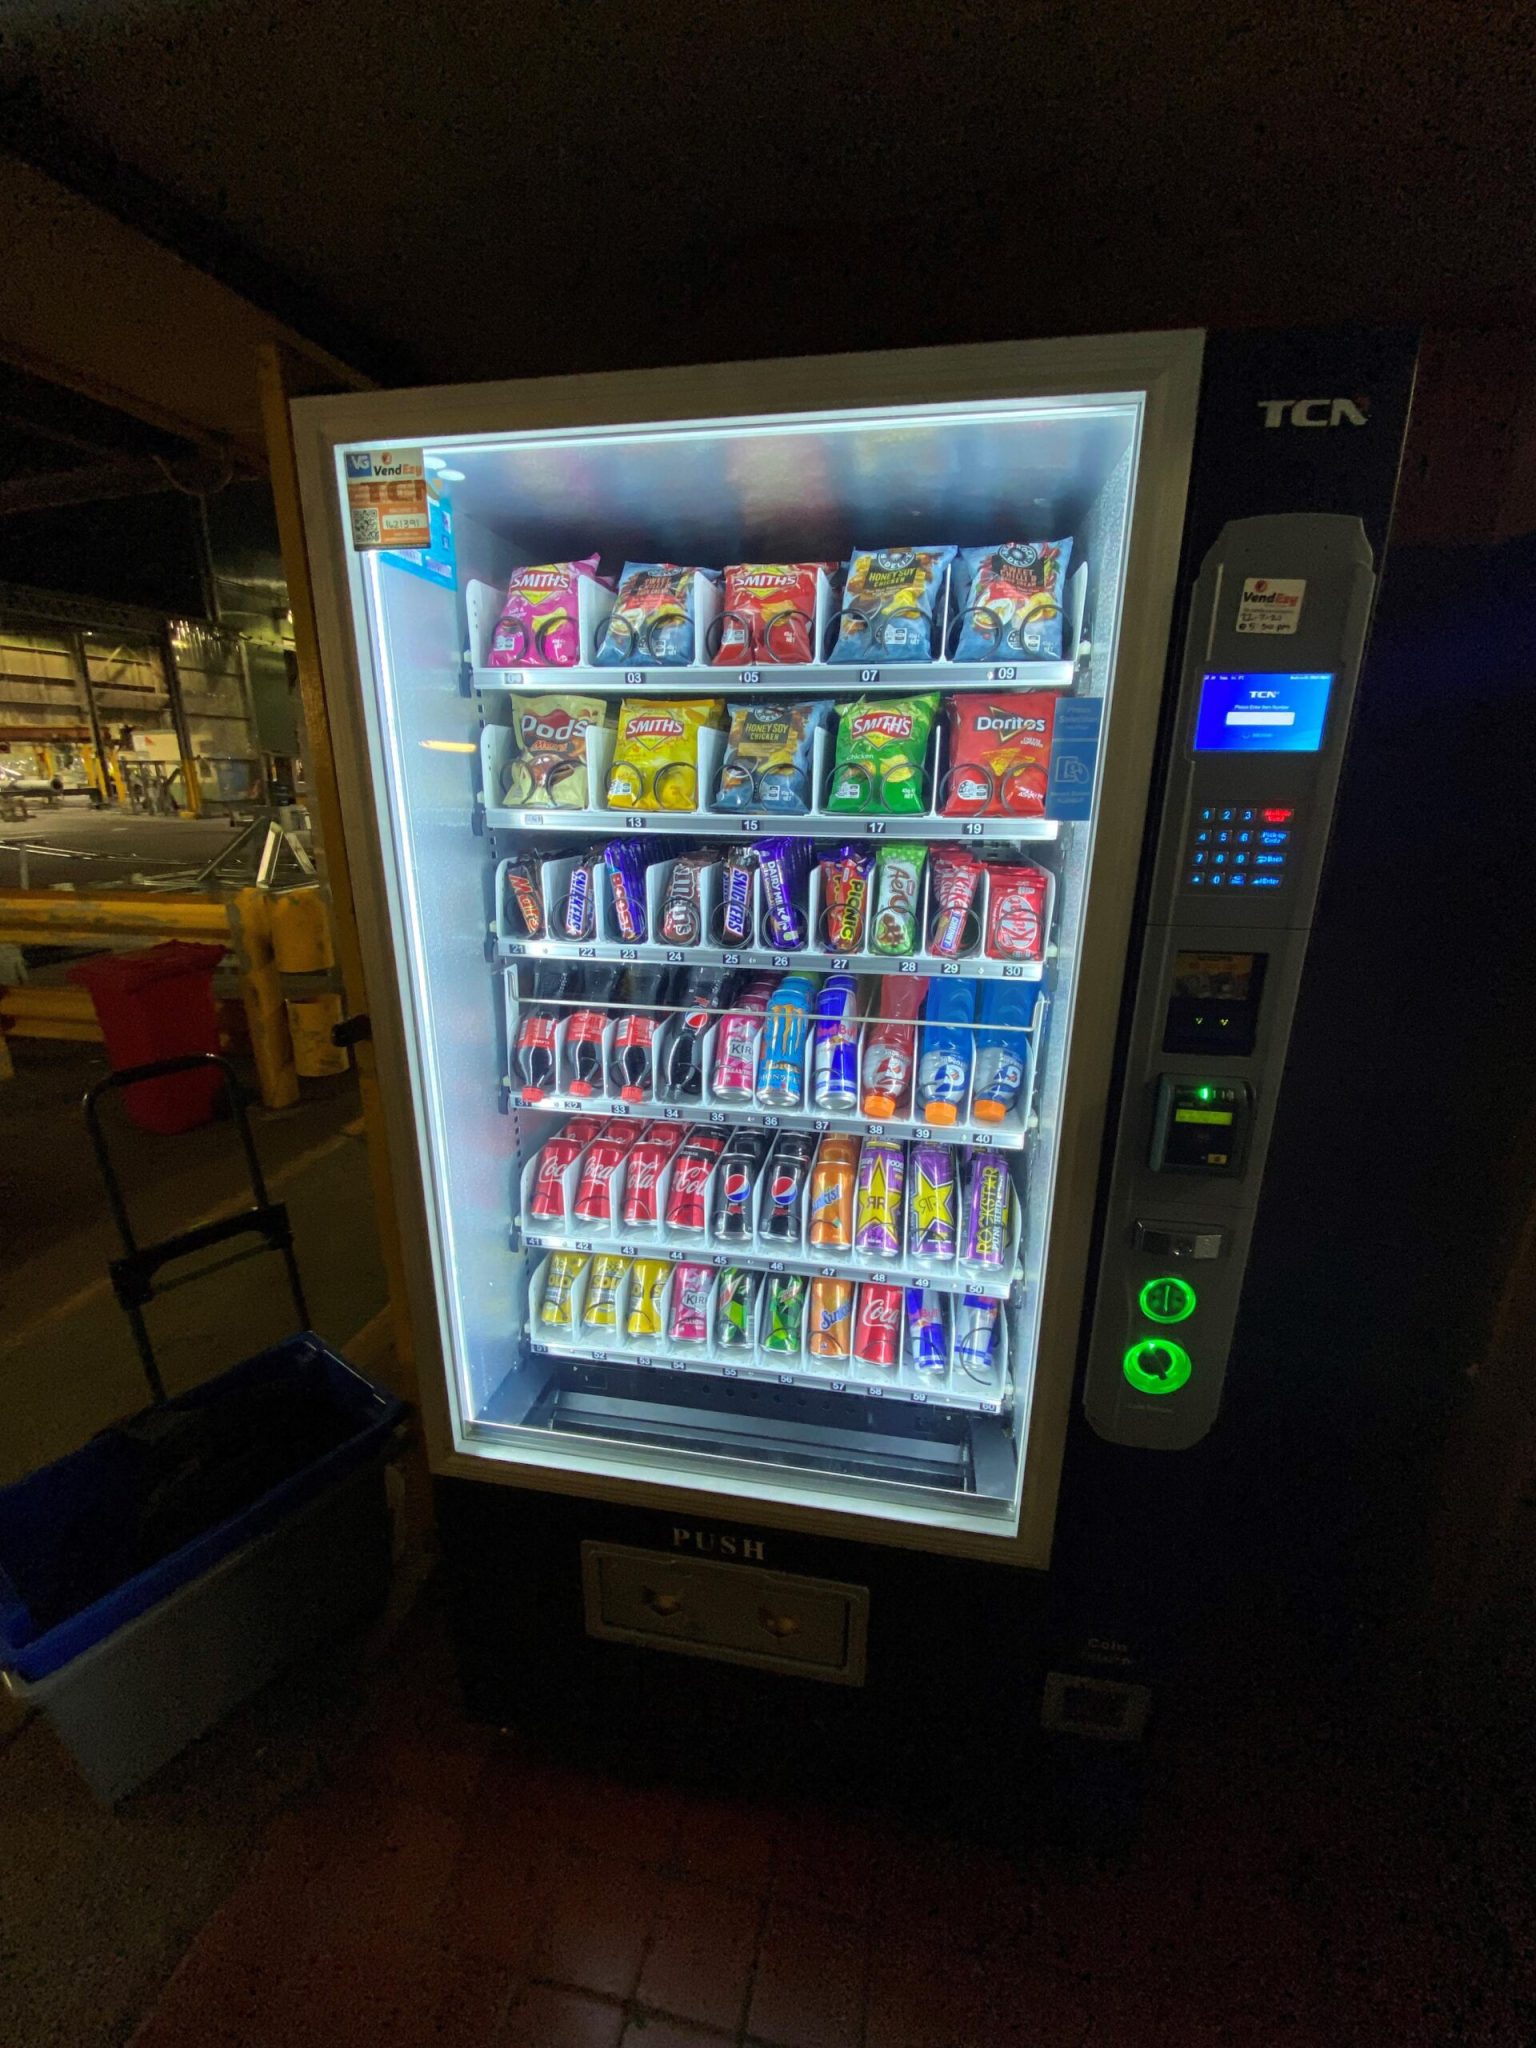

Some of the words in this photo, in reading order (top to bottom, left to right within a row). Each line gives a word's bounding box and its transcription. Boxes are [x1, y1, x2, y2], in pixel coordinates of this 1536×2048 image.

[1258, 396, 1369, 428] TCN
[351, 455, 369, 470] VG
[743, 672, 759, 683] 05
[861, 670, 878, 681] 07
[998, 667, 1015, 679] 09
[627, 673, 643, 684] 03
[1249, 691, 1279, 699] TCN
[521, 714, 588, 741] Pods
[745, 723, 772, 734] HONEY
[772, 722, 790, 735] SOY
[852, 716, 912, 738] SMITH'S
[976, 716, 1046, 732] Doritos
[750, 733, 780, 741] CHICKEN
[1223, 810, 1231, 820] 2
[1244, 810, 1252, 820] 3
[628, 817, 643, 827] 13
[743, 820, 758, 830] 15
[868, 822, 884, 833] 17
[966, 824, 983, 834] 19
[1220, 832, 1228, 841] 5
[1240, 833, 1248, 842] 6
[767, 861, 781, 889] DAIRY
[728, 868, 749, 935] SNICKERS
[839, 878, 866, 941] PICNIC
[511, 944, 524, 953] 21
[580, 948, 594, 957] 22
[623, 950, 636, 959] 23
[669, 952, 683, 961] 24
[724, 955, 738, 964] 25
[774, 957, 788, 966] 26
[833, 959, 848, 969] 27
[901, 962, 916, 972] 28
[943, 963, 959, 974] 29
[1005, 966, 1021, 976] 30
[731, 1043, 752, 1054] KIR
[614, 1106, 626, 1114] 33
[666, 1109, 679, 1118] 34
[711, 1112, 724, 1121] 35
[765, 1117, 778, 1126] 36
[815, 1121, 829, 1130] 37
[869, 1125, 883, 1135] 38
[915, 1128, 930, 1139] 39
[975, 1134, 990, 1144] 40
[539, 1156, 563, 1182] Coc
[675, 1166, 705, 1197] Col
[529, 1238, 541, 1246] 41
[577, 1242, 590, 1250] 42
[622, 1246, 635, 1255] 43
[671, 1251, 683, 1260] 44
[714, 1256, 727, 1265] 45
[771, 1262, 783, 1271] 46
[822, 1268, 835, 1276] 47
[872, 1273, 886, 1282] 48
[915, 1278, 929, 1287] 49
[969, 1285, 983, 1294] 50
[686, 1295, 708, 1305] KIR
[862, 1299, 899, 1331] Coca
[639, 1358, 651, 1366] 53
[673, 1361, 685, 1370] 54
[724, 1368, 737, 1376] 55
[780, 1375, 793, 1384] 56
[832, 1382, 845, 1391] 57
[869, 1387, 882, 1396] 58
[913, 1393, 926, 1402] 59
[673, 1527, 766, 1561] PUSH
